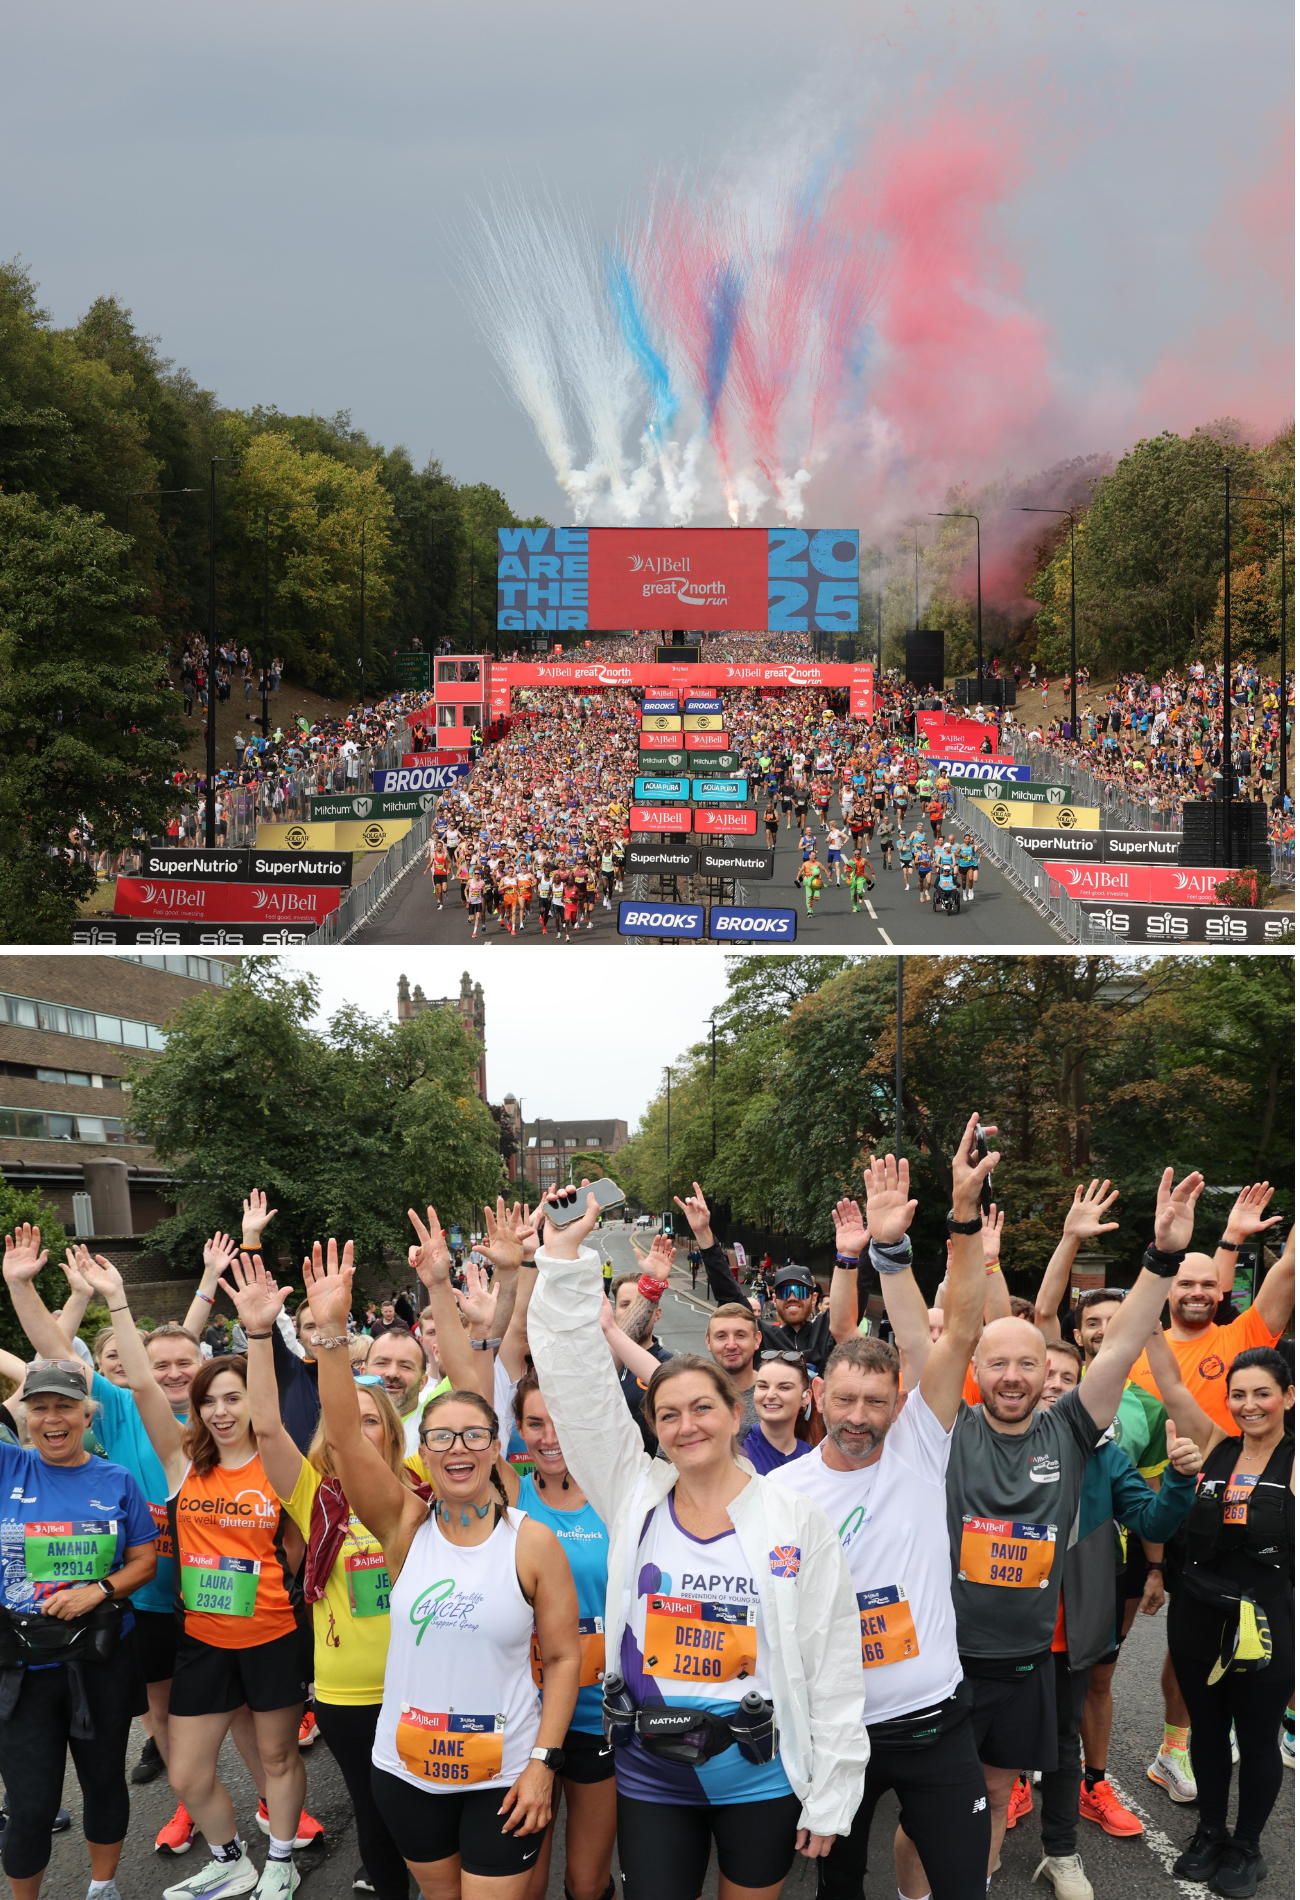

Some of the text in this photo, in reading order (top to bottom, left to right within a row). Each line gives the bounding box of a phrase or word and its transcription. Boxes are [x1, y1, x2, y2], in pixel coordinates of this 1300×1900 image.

[498, 528, 588, 552] WE
[768, 529, 859, 578] 20
[498, 556, 588, 578] ARE
[643, 557, 690, 572] AJBell
[498, 582, 588, 606] THE
[642, 580, 725, 596] great north
[705, 597, 728, 605] run
[768, 581, 859, 631] 25
[498, 610, 588, 630] GNR
[544, 667, 631, 678] AJBell great north
[734, 668, 820, 679] AJBell great north
[654, 735, 676, 744] AJBell
[699, 736, 722, 744] AJBell
[384, 766, 458, 792] BROOKS
[938, 762, 1019, 781] BROOKS
[645, 782, 662, 790] AQUA
[1012, 791, 1044, 801] Mitchum
[315, 806, 349, 815] Mitchum
[383, 802, 415, 812] Mitchum
[650, 812, 682, 824] AJBell
[715, 815, 747, 826] AJBell
[1015, 836, 1093, 850] SuperNutrio
[1110, 840, 1180, 854] SuperNutri
[150, 858, 238, 872] SuperNutrio
[630, 853, 690, 864] SuperNutrio
[706, 857, 764, 868] SuperNutrio
[256, 860, 342, 874] SuperNutrio
[1081, 872, 1128, 889] AJBell
[155, 888, 206, 908] AJBell
[266, 894, 317, 912] AJBell
[625, 912, 698, 928] BROOKS
[716, 917, 790, 932] BROOKS
[180, 1498, 276, 1518] coeliac uk
[194, 1514, 276, 1529] well gluten free
[980, 1523, 1004, 1532] AJBell
[41, 1525, 64, 1534] AJBell
[556, 1530, 603, 1540] Butterwick
[48, 1540, 98, 1557] AMANDA
[991, 1542, 1028, 1561] DAVID
[54, 1561, 93, 1576] 32914
[193, 1557, 213, 1565] AJBell
[360, 1556, 384, 1566] AJBell
[990, 1564, 1022, 1582] 9428
[200, 1574, 234, 1590] LAURA
[682, 1574, 758, 1596] PAPYRU
[196, 1593, 232, 1610] 23342
[681, 1592, 718, 1600] PREVENTION
[664, 1601, 693, 1614] AJBell
[431, 1617, 480, 1632] Support Group
[676, 1626, 725, 1651] DEBBIE
[673, 1654, 722, 1678] 12160
[415, 1714, 440, 1726] AJBell
[650, 1716, 691, 1725] NATHAN
[429, 1739, 464, 1757] JANE
[424, 1760, 468, 1780] 13965
